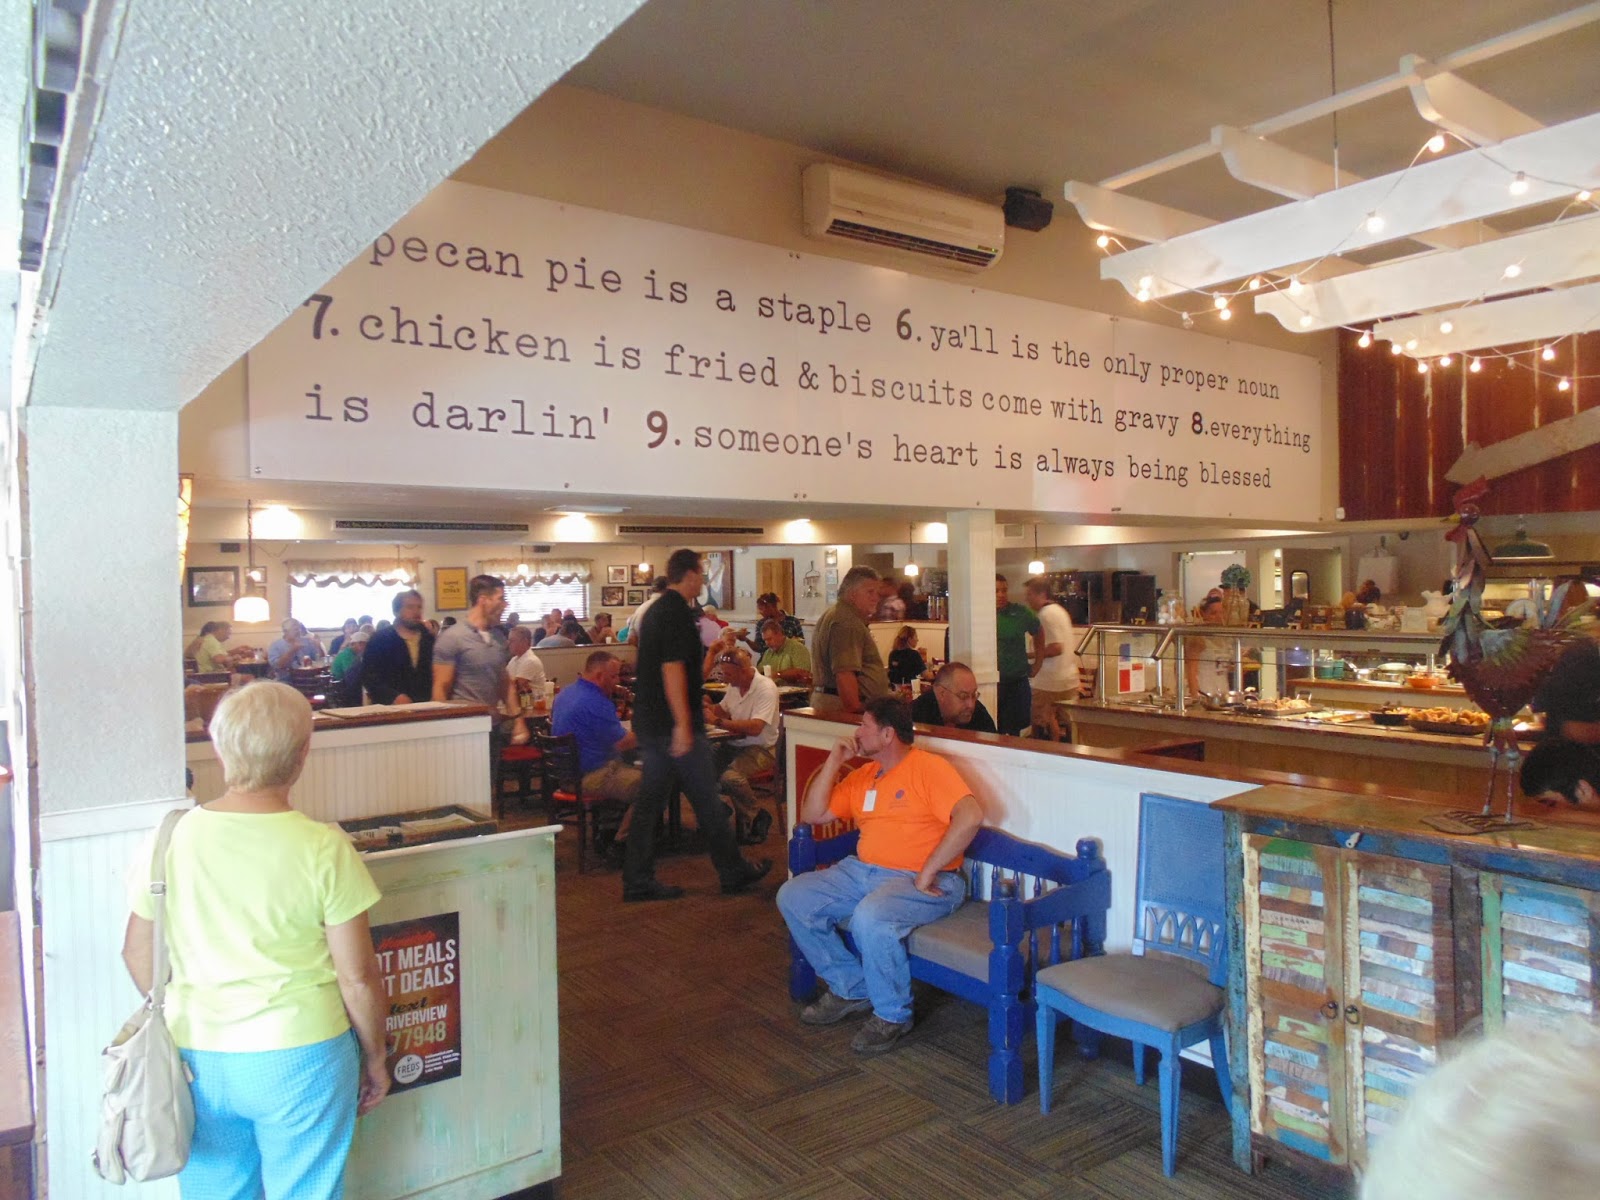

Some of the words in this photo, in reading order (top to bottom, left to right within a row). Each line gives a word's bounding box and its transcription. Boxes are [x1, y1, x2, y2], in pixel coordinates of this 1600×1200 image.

[368, 232, 525, 279] pecan
[545, 256, 622, 293] pie
[643, 268, 688, 305] is
[715, 288, 737, 313] a
[757, 292, 872, 335] staple
[929, 324, 999, 355] ya'll
[1011, 333, 1039, 361] is
[1051, 340, 1091, 369] the
[1103, 352, 1152, 384] only
[1159, 364, 1229, 393] proper
[1237, 378, 1280, 400] noun
[302, 293, 340, 340] 7.
[358, 305, 572, 363] chicken
[593, 334, 641, 371] is
[664, 343, 780, 388] fried
[797, 360, 820, 391] &
[828, 363, 973, 409] biscuits
[981, 391, 1043, 417] come
[1049, 396, 1104, 425] with
[1114, 409, 1180, 438] gravy
[304, 383, 369, 424] is
[411, 390, 609, 440] darlin'
[646, 410, 681, 450] 9.
[694, 425, 873, 460] someone's
[892, 433, 979, 467] heart
[994, 443, 1023, 471] is
[1036, 447, 1115, 483] always
[1126, 454, 1189, 489] being
[1198, 460, 1272, 489] blessed
[398, 939, 456, 970] MEALS
[401, 963, 454, 994] DEALS
[386, 1004, 447, 1032] RIVERVIEW
[392, 1021, 446, 1053] 77948
[397, 1062, 420, 1075] FREDS
